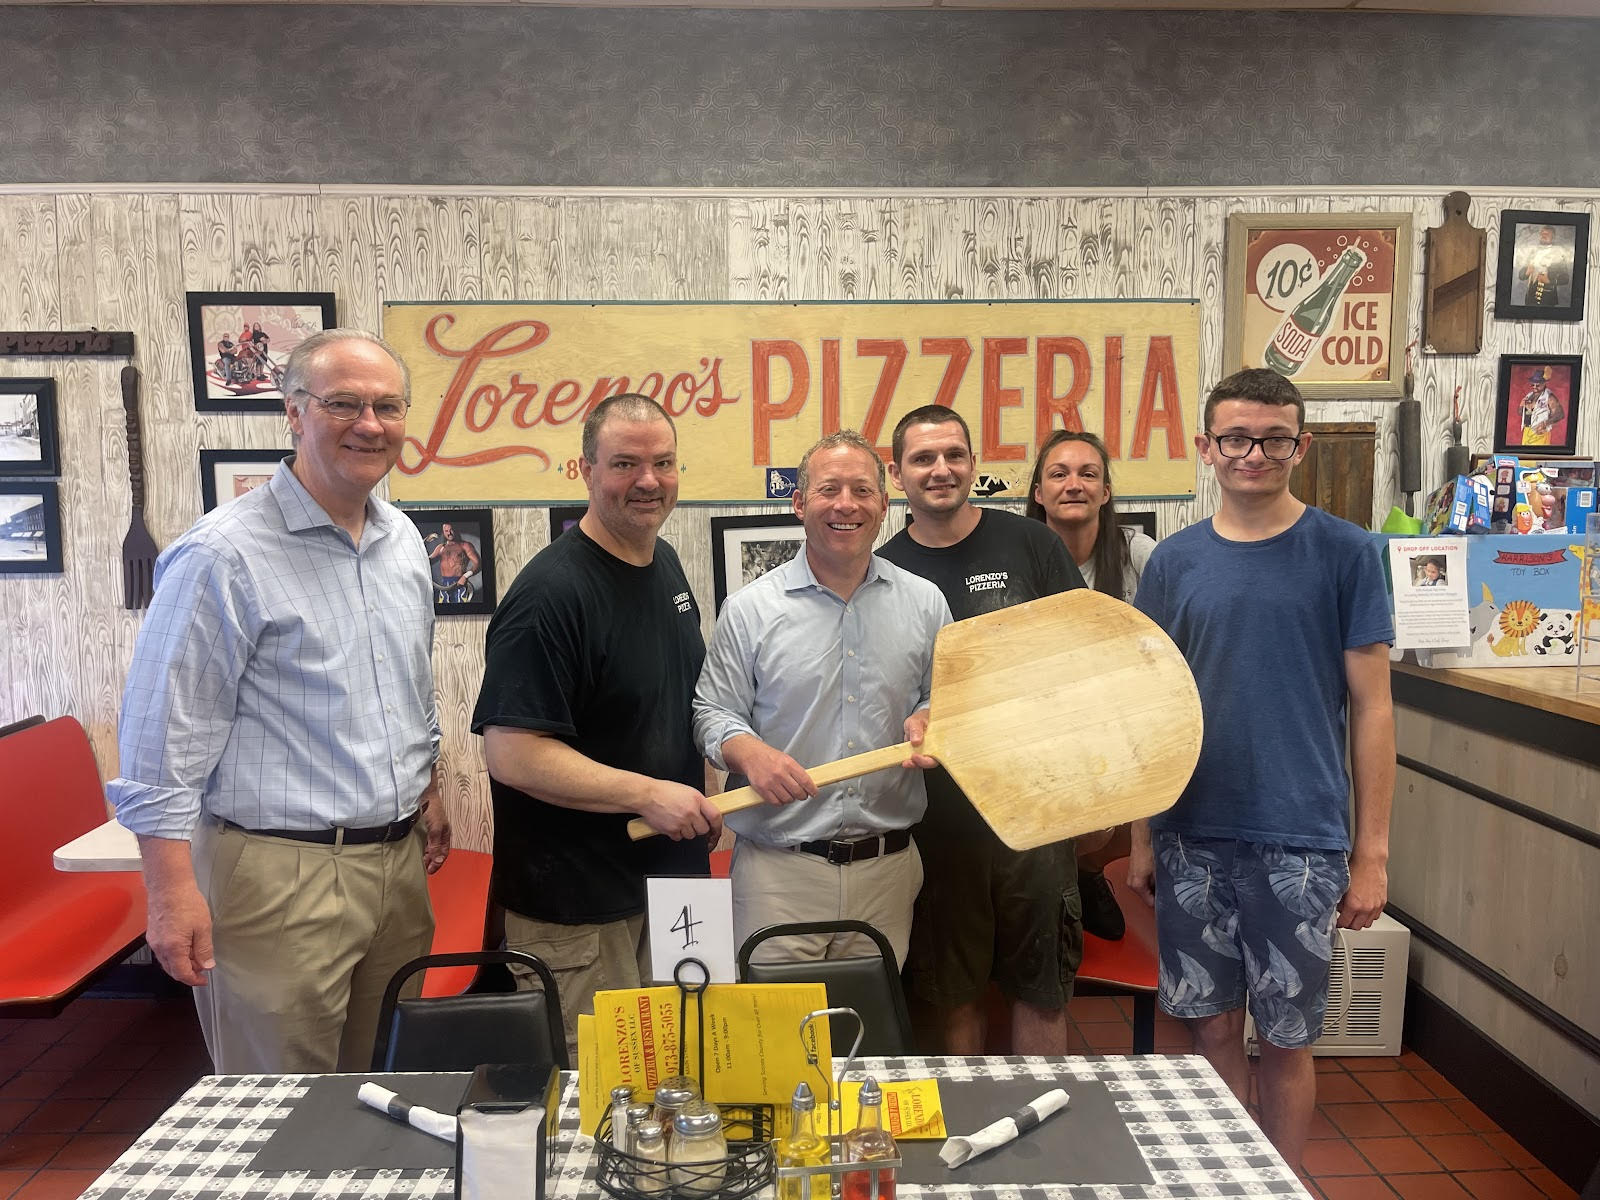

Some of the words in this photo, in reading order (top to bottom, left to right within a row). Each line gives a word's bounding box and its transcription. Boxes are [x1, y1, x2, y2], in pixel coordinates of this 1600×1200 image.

[1264, 258, 1313, 300] 10¢
[1343, 301, 1379, 331] ICE
[1276, 321, 1313, 359] SODA
[1321, 335, 1384, 366] COLD
[751, 335, 1189, 466] PIZZERIA
[965, 571, 1009, 586] LORENZO'S
[969, 580, 1007, 593] PIZZERIA
[1510, 567, 1527, 577] TOY
[1532, 567, 1550, 577] BOX
[670, 904, 703, 950] 4
[639, 997, 653, 1046] RESTAURANT
[614, 1006, 632, 1083] LORENZO'S
[630, 1031, 640, 1061] SUSSEX
[659, 1002, 679, 1074] 973-875-5055
[712, 1037, 720, 1051] Days
[808, 1023, 817, 1053] facebook
[634, 1063, 641, 1073] OF
[646, 1056, 658, 1089] PIZZERIA
[714, 1057, 722, 1073] Open
